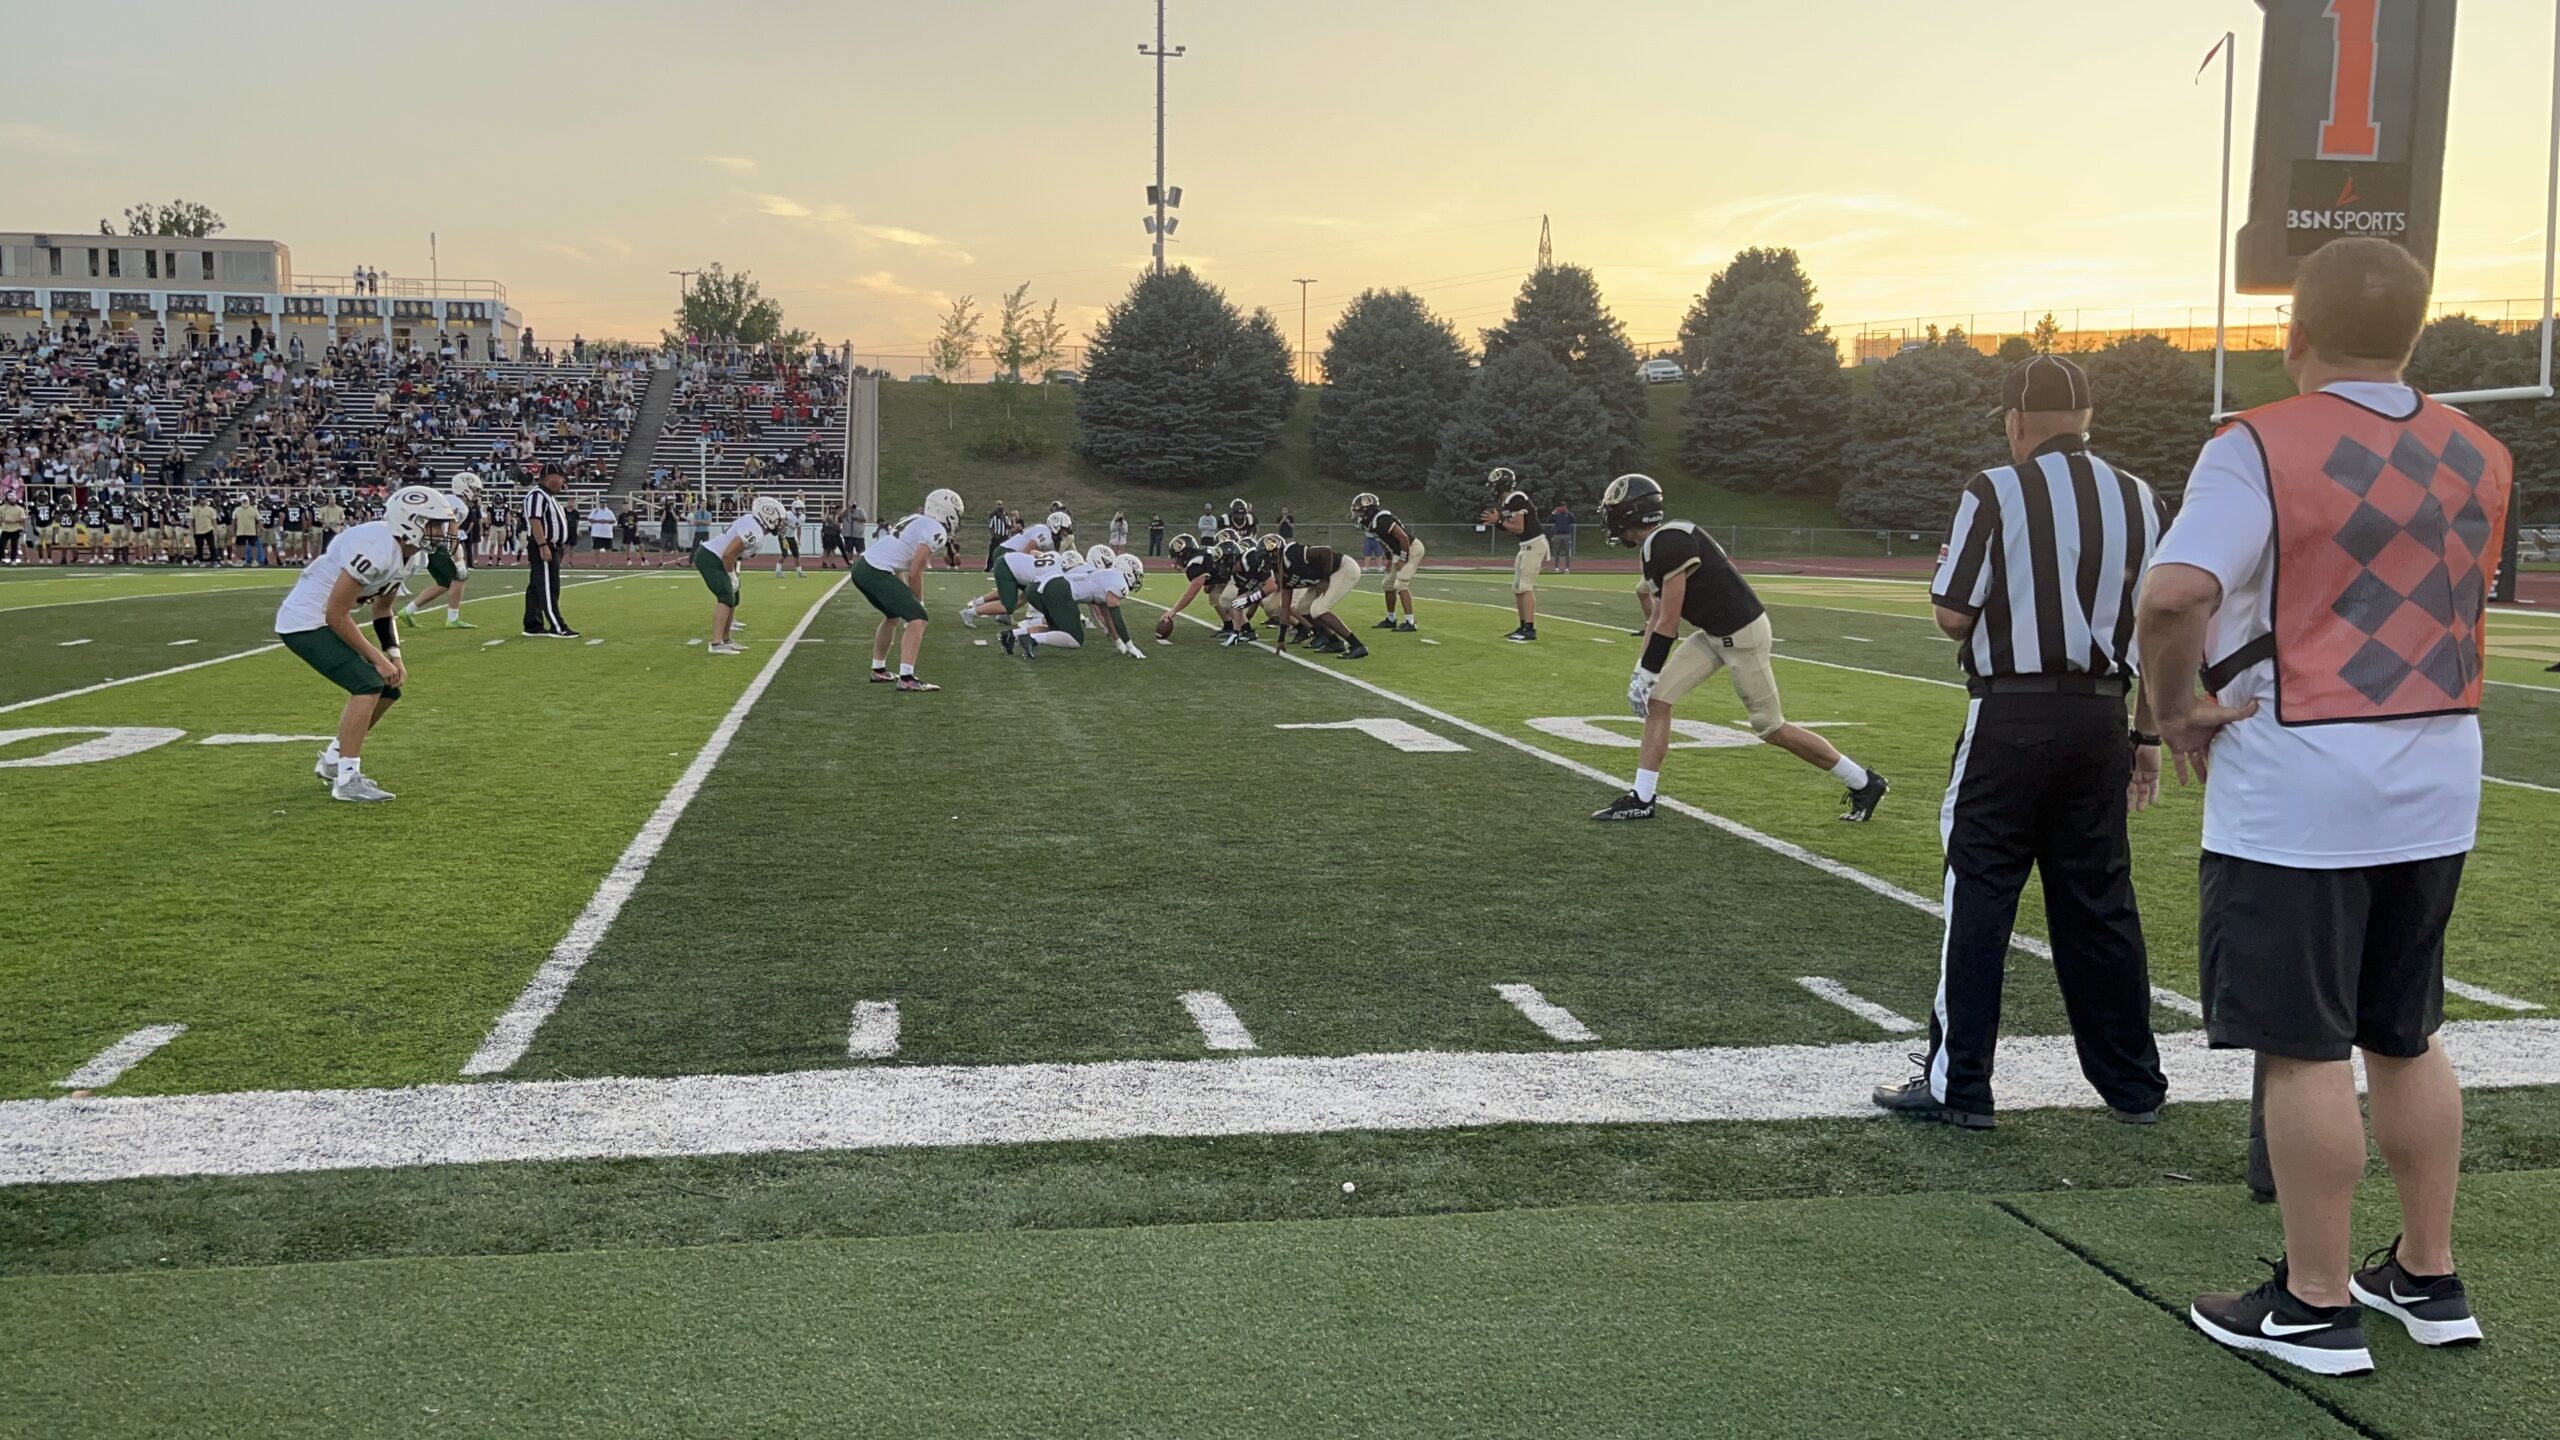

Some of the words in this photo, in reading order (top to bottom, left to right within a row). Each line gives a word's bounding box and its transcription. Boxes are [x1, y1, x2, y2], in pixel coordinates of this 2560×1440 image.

[2287, 210, 2331, 229] BSN
[2334, 211, 2405, 231] SPORTS
[744, 531, 756, 543] 36
[350, 553, 372, 573] 10
